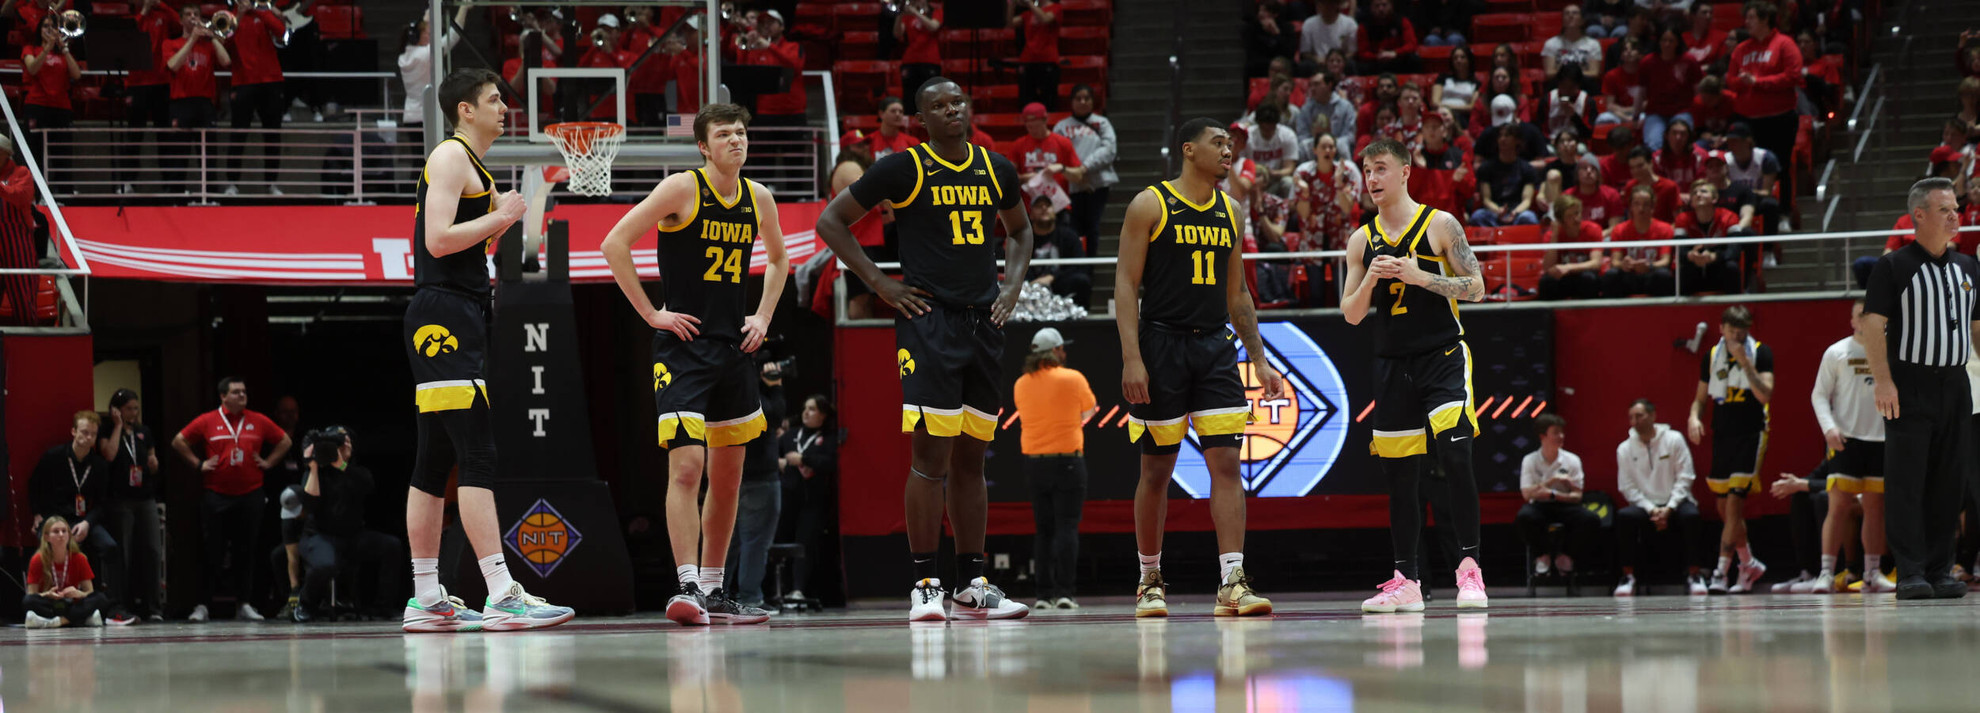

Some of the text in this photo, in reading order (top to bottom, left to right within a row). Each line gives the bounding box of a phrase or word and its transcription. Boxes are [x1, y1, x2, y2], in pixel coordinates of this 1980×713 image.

[930, 185, 993, 205] IOWA
[700, 219, 752, 244] IOWA
[949, 211, 985, 245] 13
[1174, 224, 1232, 248] IOWA
[703, 246, 742, 284] 24
[1191, 250, 1216, 286] 11
[1389, 282, 1408, 316] 2
[524, 323, 550, 437] NIT
[522, 531, 564, 546] NIT
